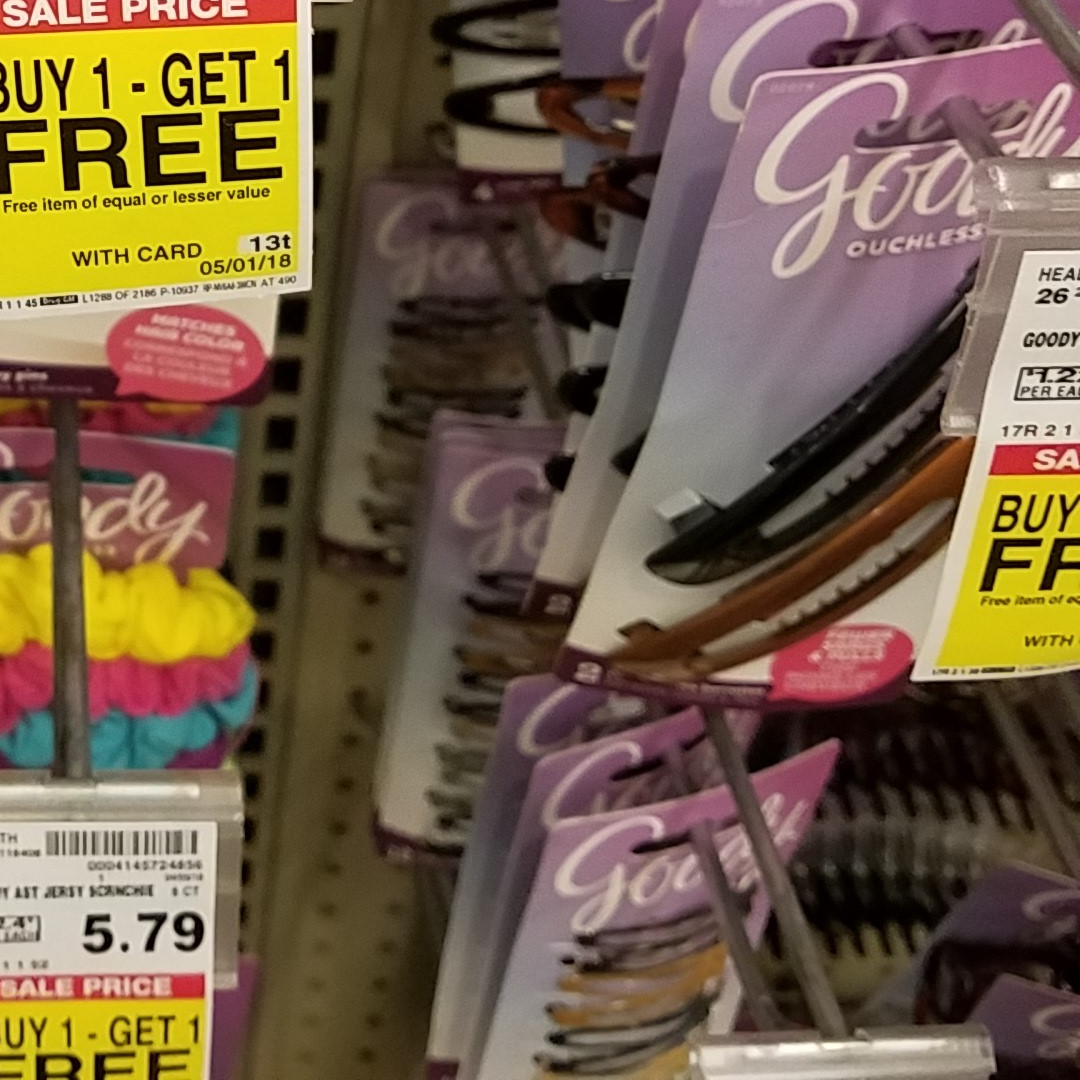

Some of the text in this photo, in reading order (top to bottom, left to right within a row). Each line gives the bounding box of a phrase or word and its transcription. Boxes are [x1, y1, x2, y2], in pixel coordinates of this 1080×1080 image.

[92, 57, 110, 110] 1
[161, 50, 256, 108] GET
[274, 50, 290, 102] 1
[3, 186, 271, 214] Free item of equal or lesser value
[249, 234, 292, 252] 13t
[845, 222, 985, 259] OUCHLESS
[72, 242, 202, 268] WITH CARD
[200, 254, 292, 276] 05/01/18
[6, 300, 12, 310] 1
[17, 299, 22, 309] 1
[25, 298, 38, 309] 45
[115, 291, 130, 302] OF
[133, 288, 157, 300] 2186
[262, 277, 274, 288] AT
[1034, 288, 1070, 304] 26
[1020, 386, 1052, 397] PER
[1002, 424, 1072, 437] 17R 2 1
[992, 494, 1080, 534] BUY
[980, 594, 1064, 607] Free item of
[1024, 634, 1074, 648] WITH
[182, 886, 200, 897] CT
[82, 910, 205, 954] 5.79
[82, 976, 173, 998] PRICE
[62, 1018, 73, 1048] 1
[110, 1014, 176, 1047] GET
[188, 1014, 200, 1045] 1
